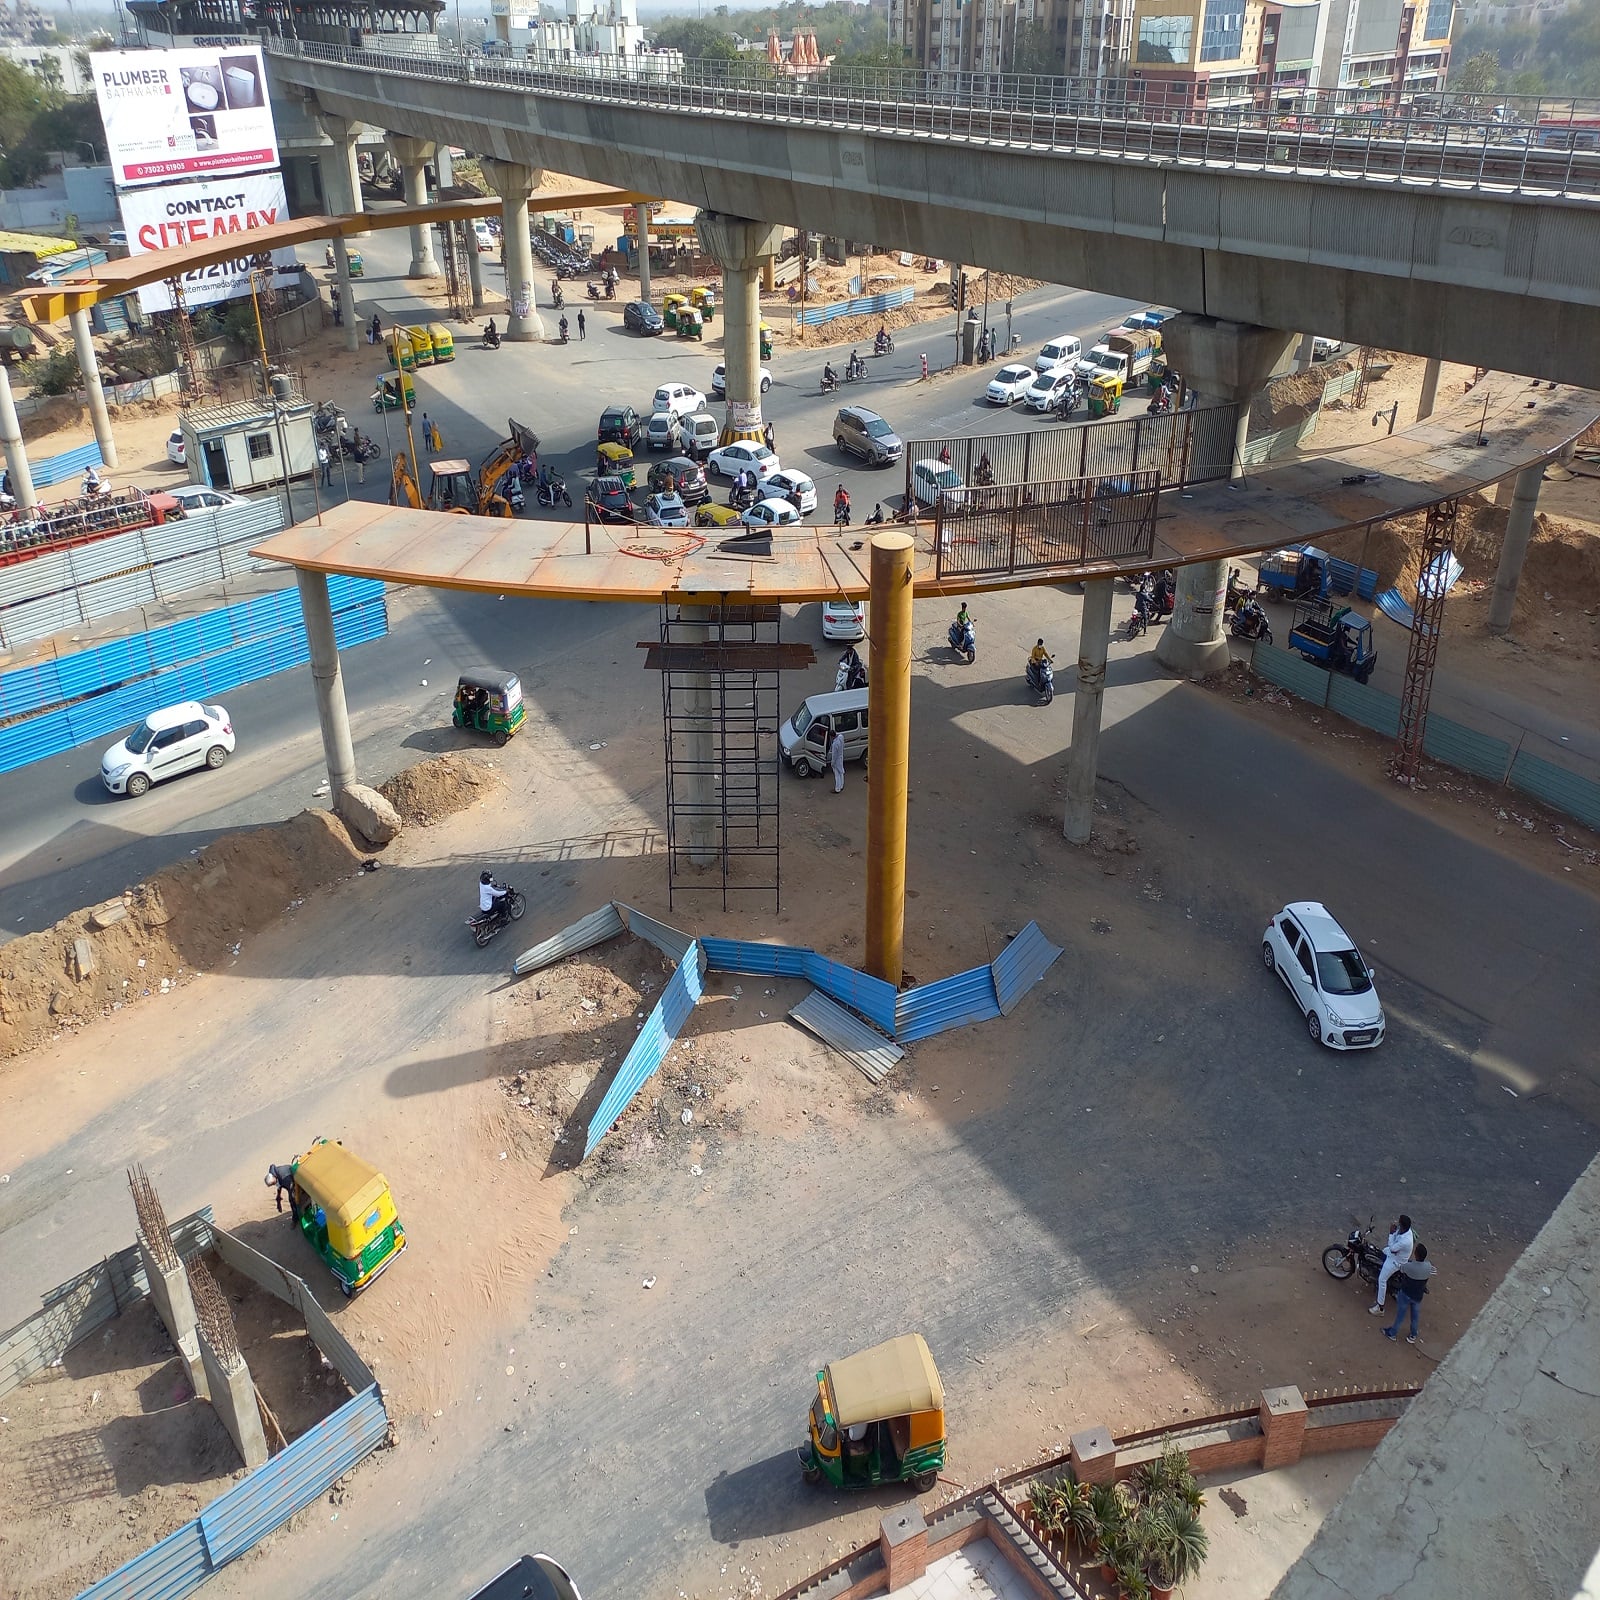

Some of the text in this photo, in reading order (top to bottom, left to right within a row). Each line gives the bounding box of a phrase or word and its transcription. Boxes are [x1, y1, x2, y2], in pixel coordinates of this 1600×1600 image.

[102, 69, 169, 87] PLUMBER
[106, 85, 165, 100] BATHWARE
[144, 165, 165, 174] 73022
[166, 193, 246, 216] CONTACT
